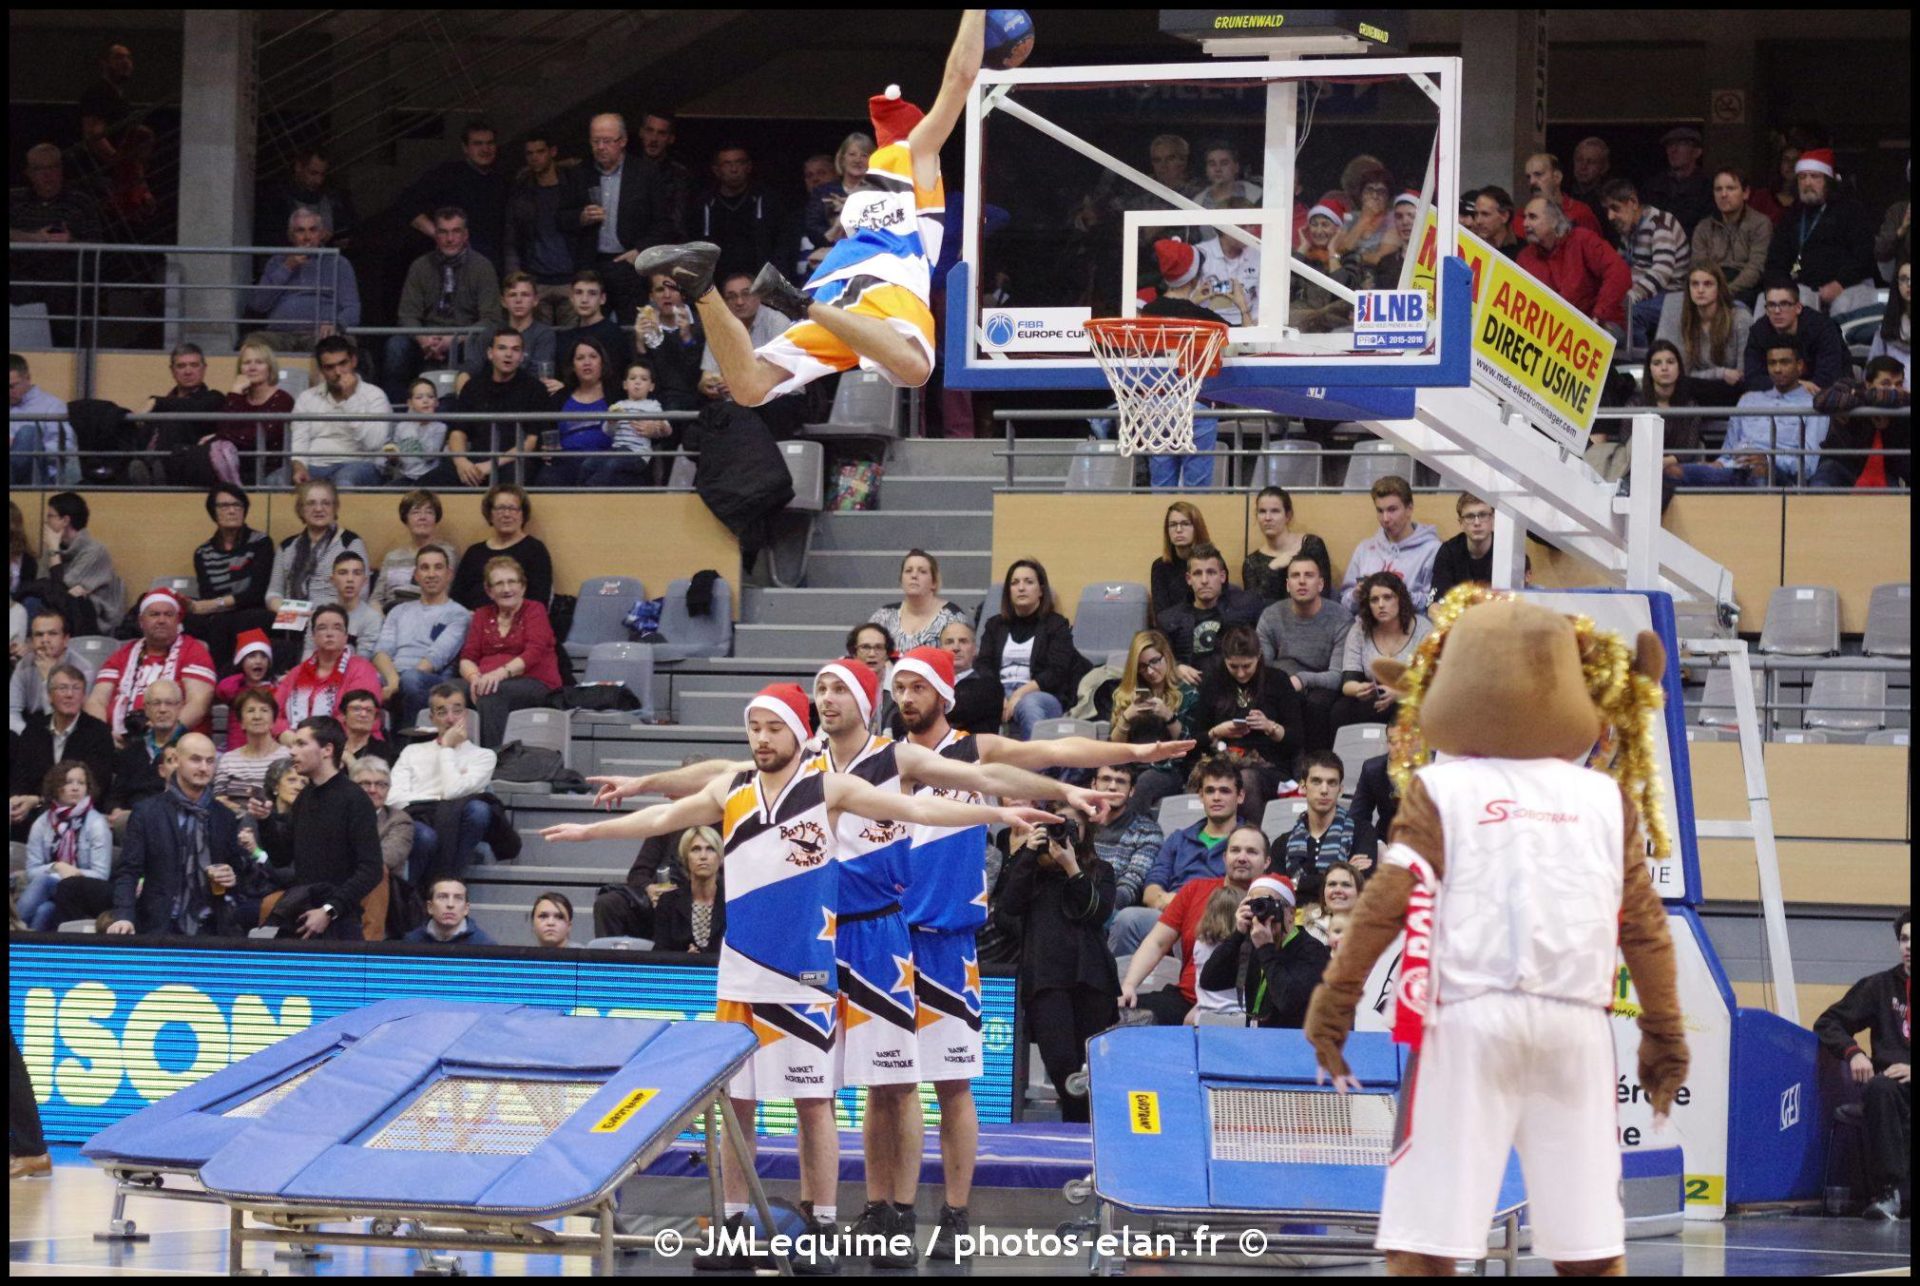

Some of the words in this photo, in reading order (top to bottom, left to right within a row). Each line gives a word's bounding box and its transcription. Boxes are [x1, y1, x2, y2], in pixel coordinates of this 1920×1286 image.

[1214, 15, 1284, 29] GRUNENWALD
[1017, 320, 1044, 329] FIBA
[1017, 330, 1063, 339] EUROPE
[1492, 281, 1603, 381] ARRIVAGE
[1482, 313, 1543, 378] DIRECT
[1542, 357, 1592, 415] USINE
[1475, 357, 1577, 438] www.mda-electromenager.com
[876, 1049, 901, 1058] BASKET
[788, 1065, 814, 1074] BASKET
